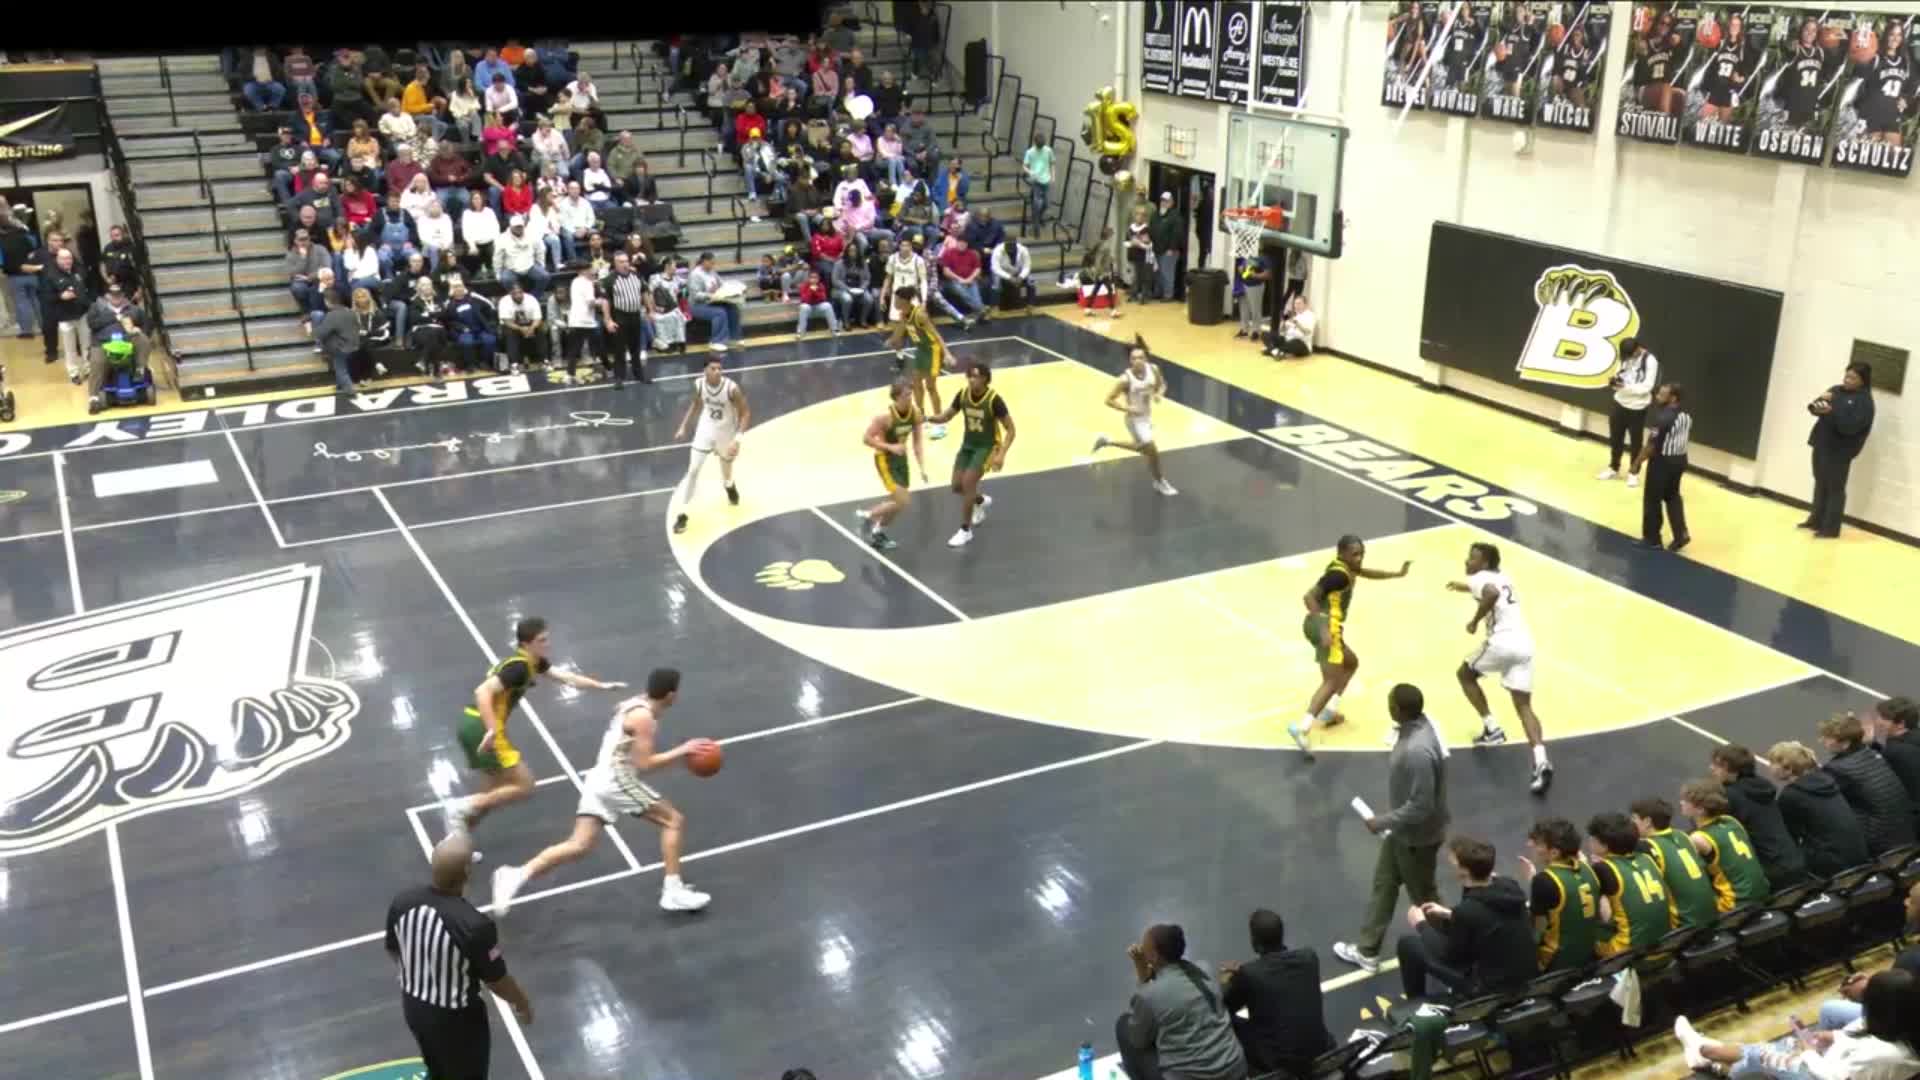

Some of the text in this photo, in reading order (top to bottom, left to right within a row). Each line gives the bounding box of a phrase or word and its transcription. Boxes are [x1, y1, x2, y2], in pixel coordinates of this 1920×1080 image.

[1492, 96, 1526, 119] WARE
[1543, 102, 1591, 127] WILCOX
[1620, 111, 1678, 141] STOVALL
[1695, 120, 1742, 147] WHITE
[0, 144, 64, 159] RESTLING
[1759, 128, 1824, 159] OSBORN
[1836, 139, 1912, 171] SCHULTZ
[63, 374, 531, 448] BRADLEY
[1257, 424, 1538, 520] BEARS
[1728, 831, 1752, 859] 4
[1578, 882, 1596, 918] 5
[1632, 869, 1665, 904] 14
